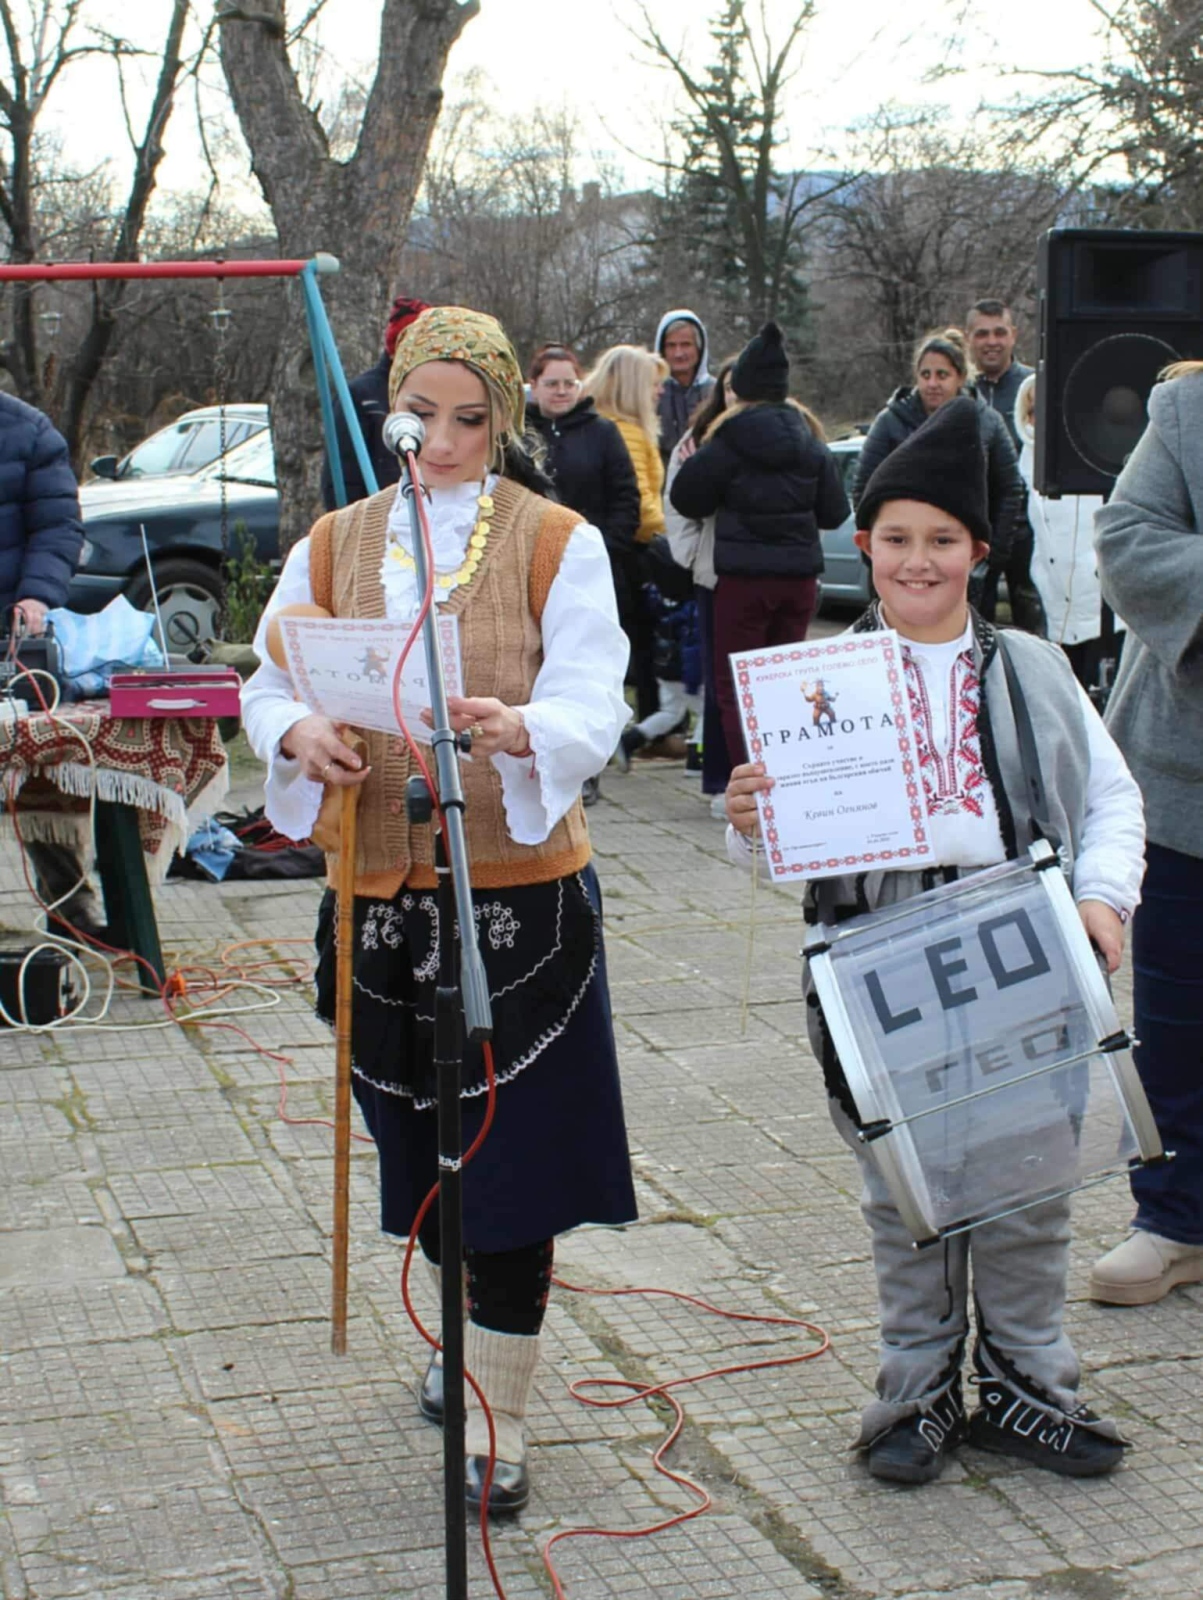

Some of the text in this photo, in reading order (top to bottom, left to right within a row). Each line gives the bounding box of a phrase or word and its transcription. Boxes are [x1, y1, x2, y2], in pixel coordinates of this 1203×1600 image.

[795, 666, 820, 676] ГРУПА
[762, 713, 893, 746] ГРАМОТА
[863, 907, 1052, 1034] LEO
